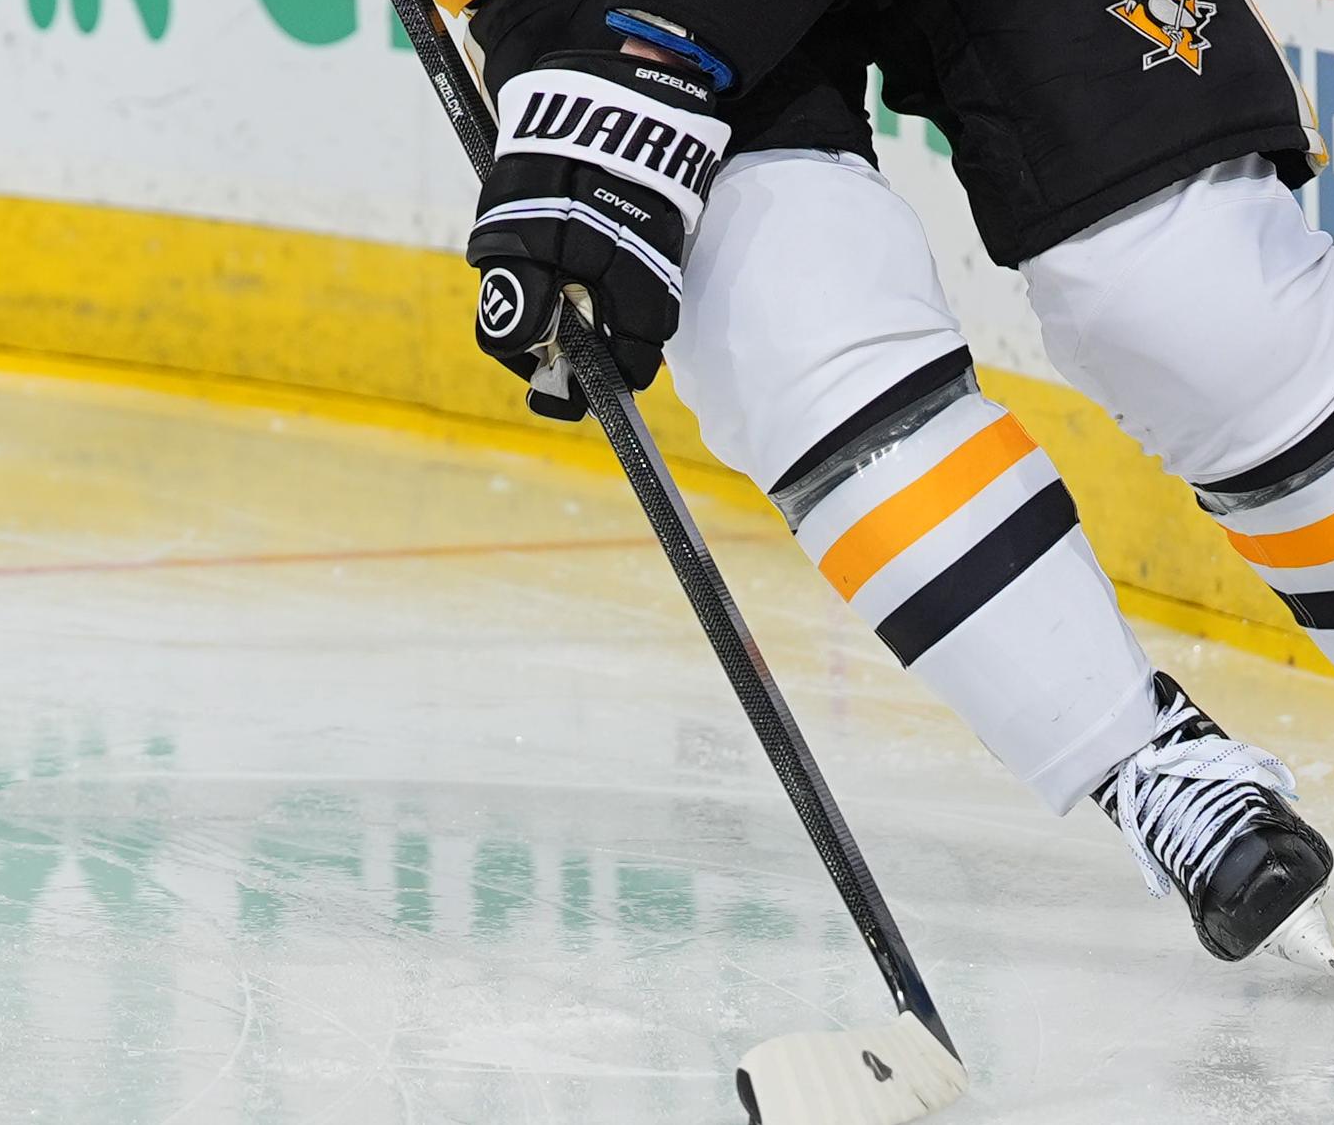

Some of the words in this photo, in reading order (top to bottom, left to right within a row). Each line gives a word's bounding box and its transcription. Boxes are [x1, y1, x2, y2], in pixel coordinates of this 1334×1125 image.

[434, 72, 464, 123] GRZELCYK
[635, 68, 708, 102] GRZELCYK
[593, 187, 651, 222] COVERT
